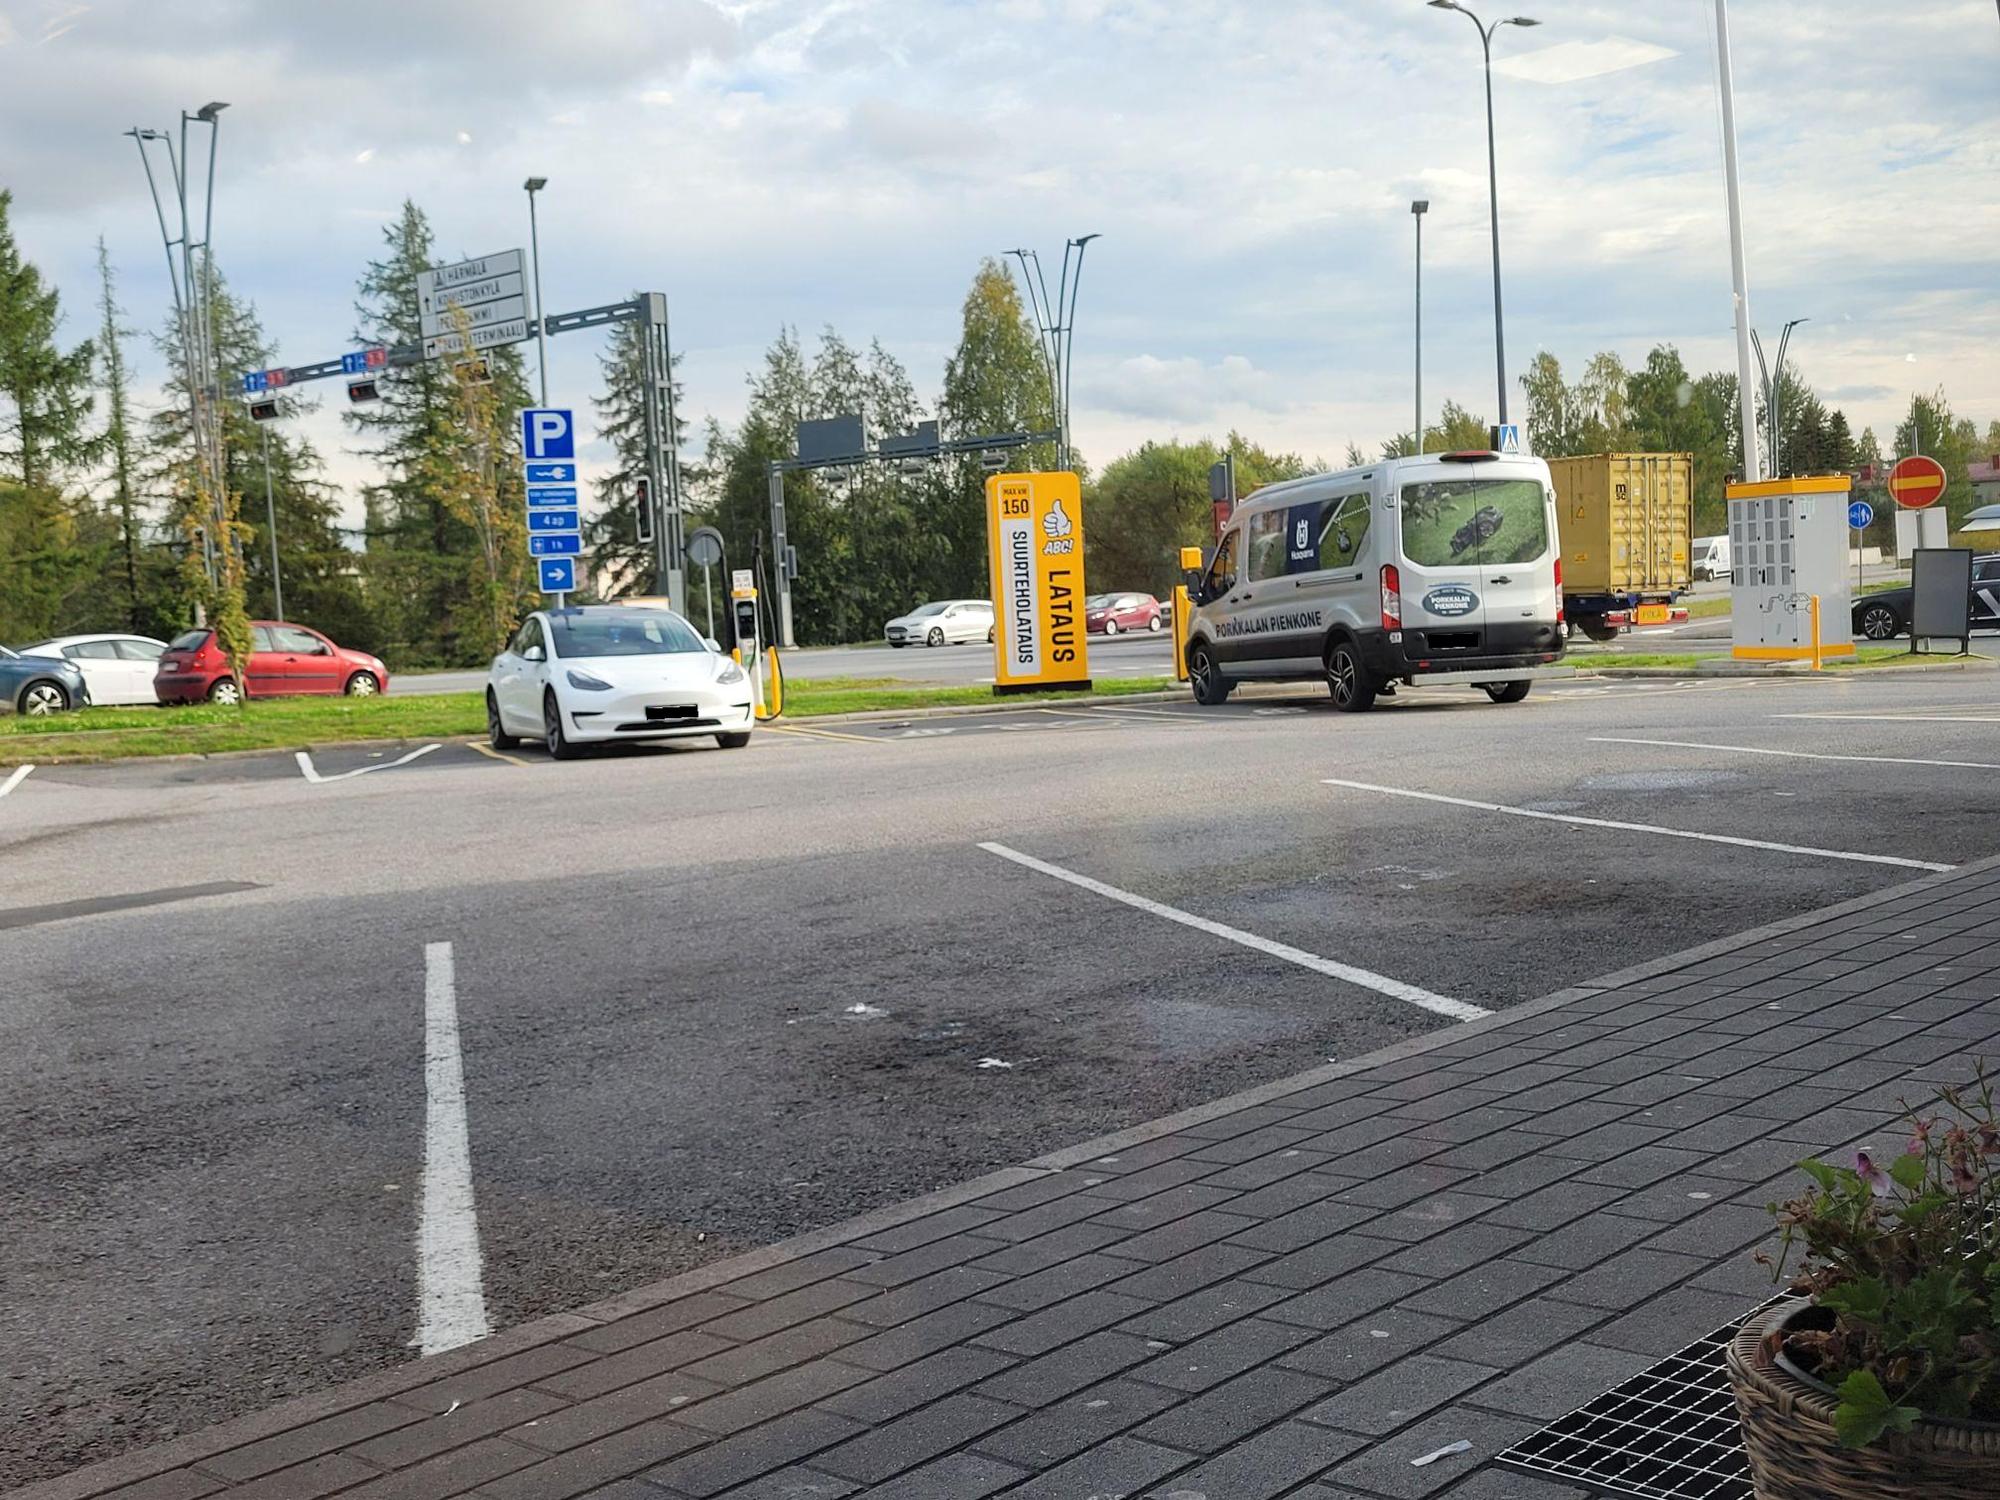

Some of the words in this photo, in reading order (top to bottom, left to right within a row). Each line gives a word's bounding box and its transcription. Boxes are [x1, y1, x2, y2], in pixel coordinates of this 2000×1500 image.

[533, 412, 567, 456] P
[544, 515, 550, 526] 4
[1003, 499, 1029, 514] 150
[1012, 531, 1033, 663] SUURTEHOLATAUS
[1048, 570, 1075, 663] LATAUS
[1216, 617, 1269, 638] PORKKALAN
[1270, 611, 1322, 631] PIENKONE
